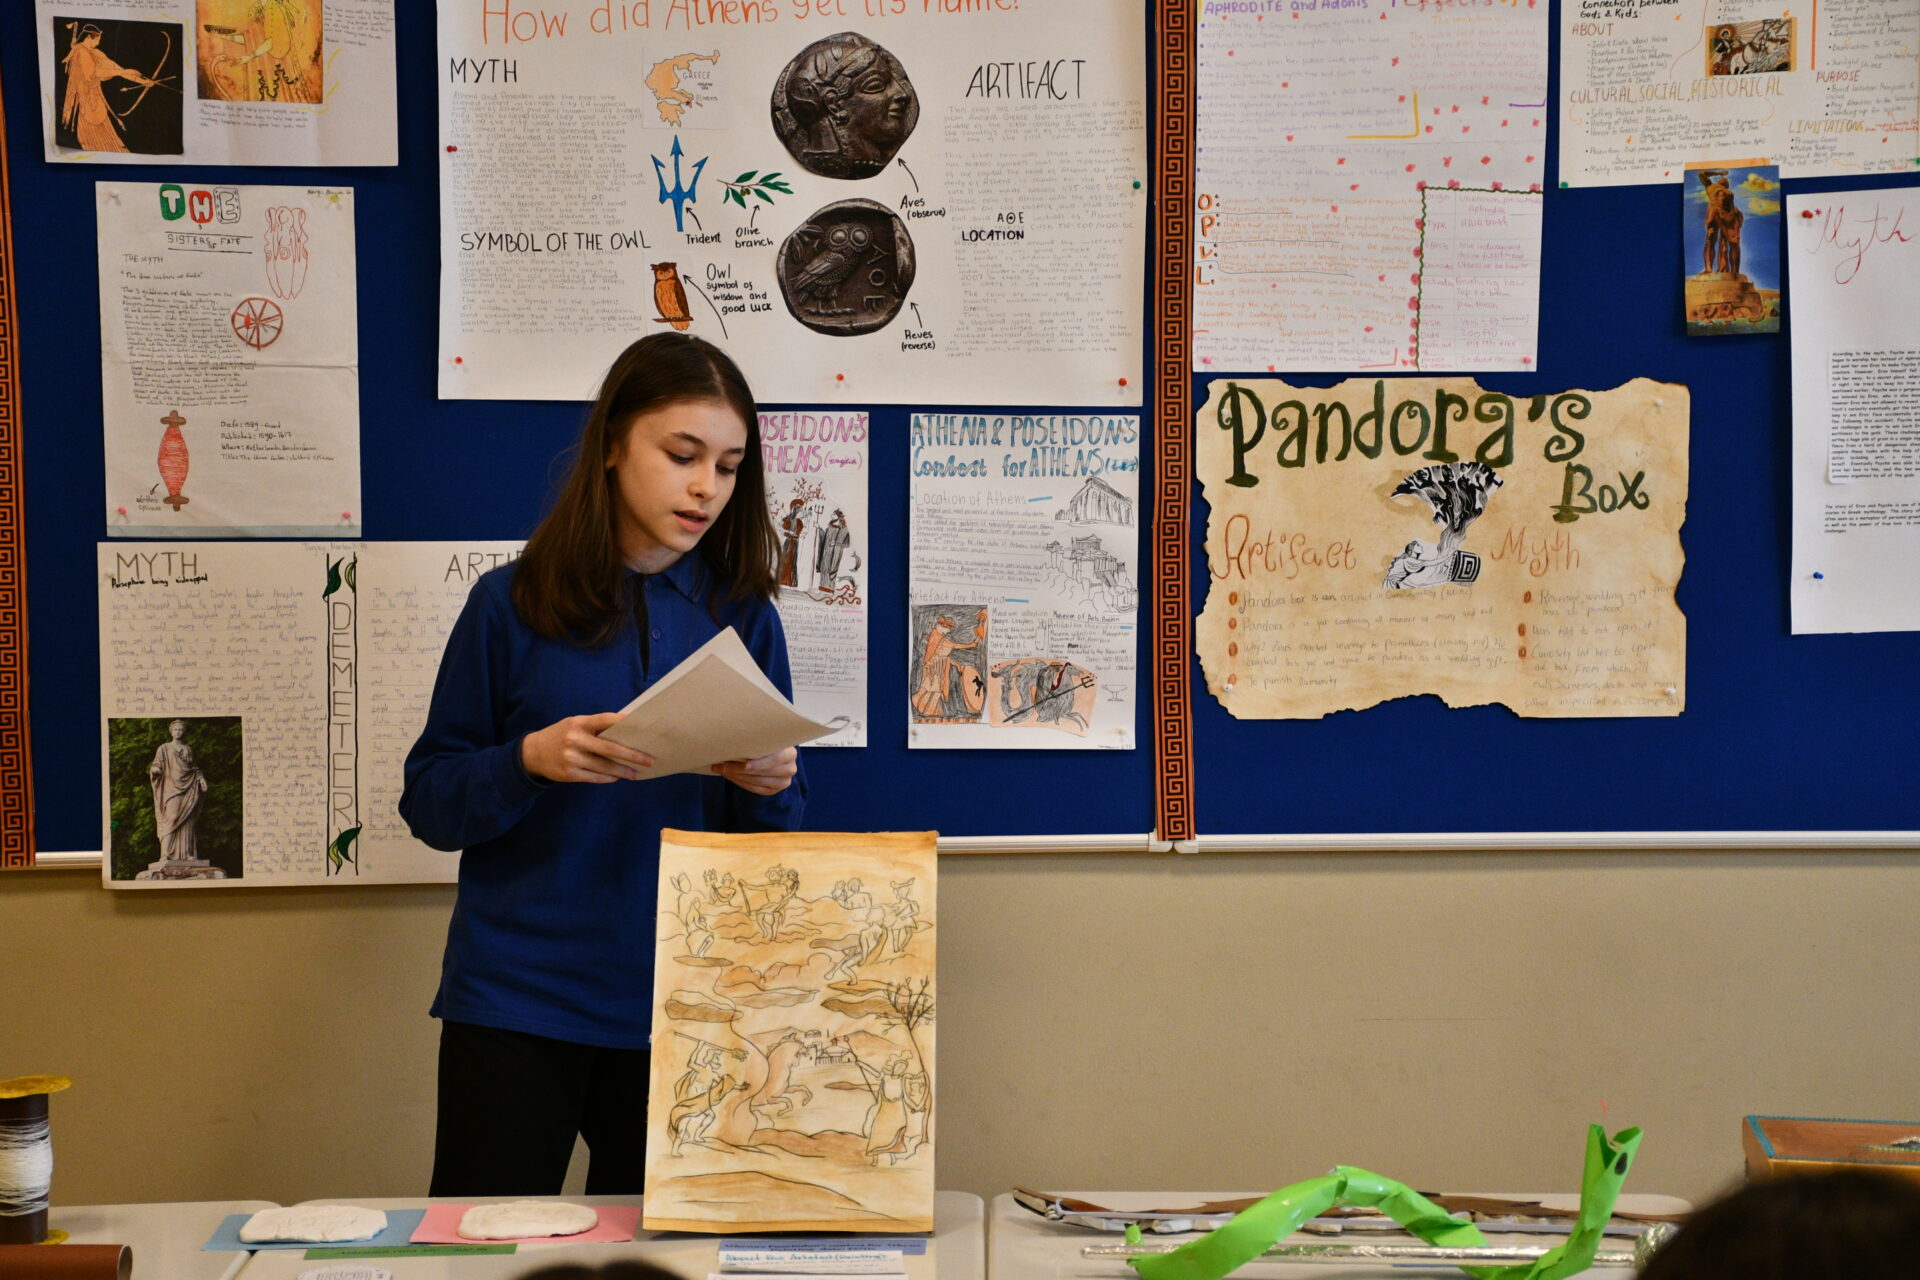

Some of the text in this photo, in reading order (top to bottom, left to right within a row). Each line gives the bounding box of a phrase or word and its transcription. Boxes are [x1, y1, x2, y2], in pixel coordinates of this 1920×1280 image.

[482, 0, 567, 44] How
[590, 0, 649, 34] did
[665, 0, 778, 30] Athens
[924, 0, 1019, 13] name
[1572, 23, 1614, 37] ABOUT
[450, 58, 518, 84] MYTH
[966, 60, 1086, 100] ARTIFACT
[1816, 70, 1861, 83] PURPOSE
[159, 184, 242, 225] THE
[900, 195, 926, 209] Aves
[167, 234, 211, 246] SISTERS
[220, 237, 241, 245] FATE
[460, 230, 652, 252] SYMBOL OF THE OWL
[685, 232, 722, 244] Trident
[735, 237, 774, 249] branch
[736, 227, 761, 237] Olive
[961, 229, 1025, 242] LOCATION
[1805, 203, 1918, 285] Myth
[706, 263, 731, 281] Owl
[706, 281, 753, 292] symbol of
[713, 291, 767, 301] wisdom and
[722, 303, 746, 315] good
[911, 415, 988, 446] ATHENA
[990, 417, 1005, 446] &
[1218, 379, 1591, 488] Pandora's
[761, 444, 823, 473] THENS
[913, 446, 988, 478] Contest
[1002, 454, 1028, 478] for
[1029, 447, 1104, 478] ATHENS
[914, 484, 1028, 506] Location of Athens
[1549, 461, 1651, 524] Box
[1491, 526, 1581, 577] Myth
[116, 551, 197, 582] MYTH
[331, 601, 354, 826] DEMETER
